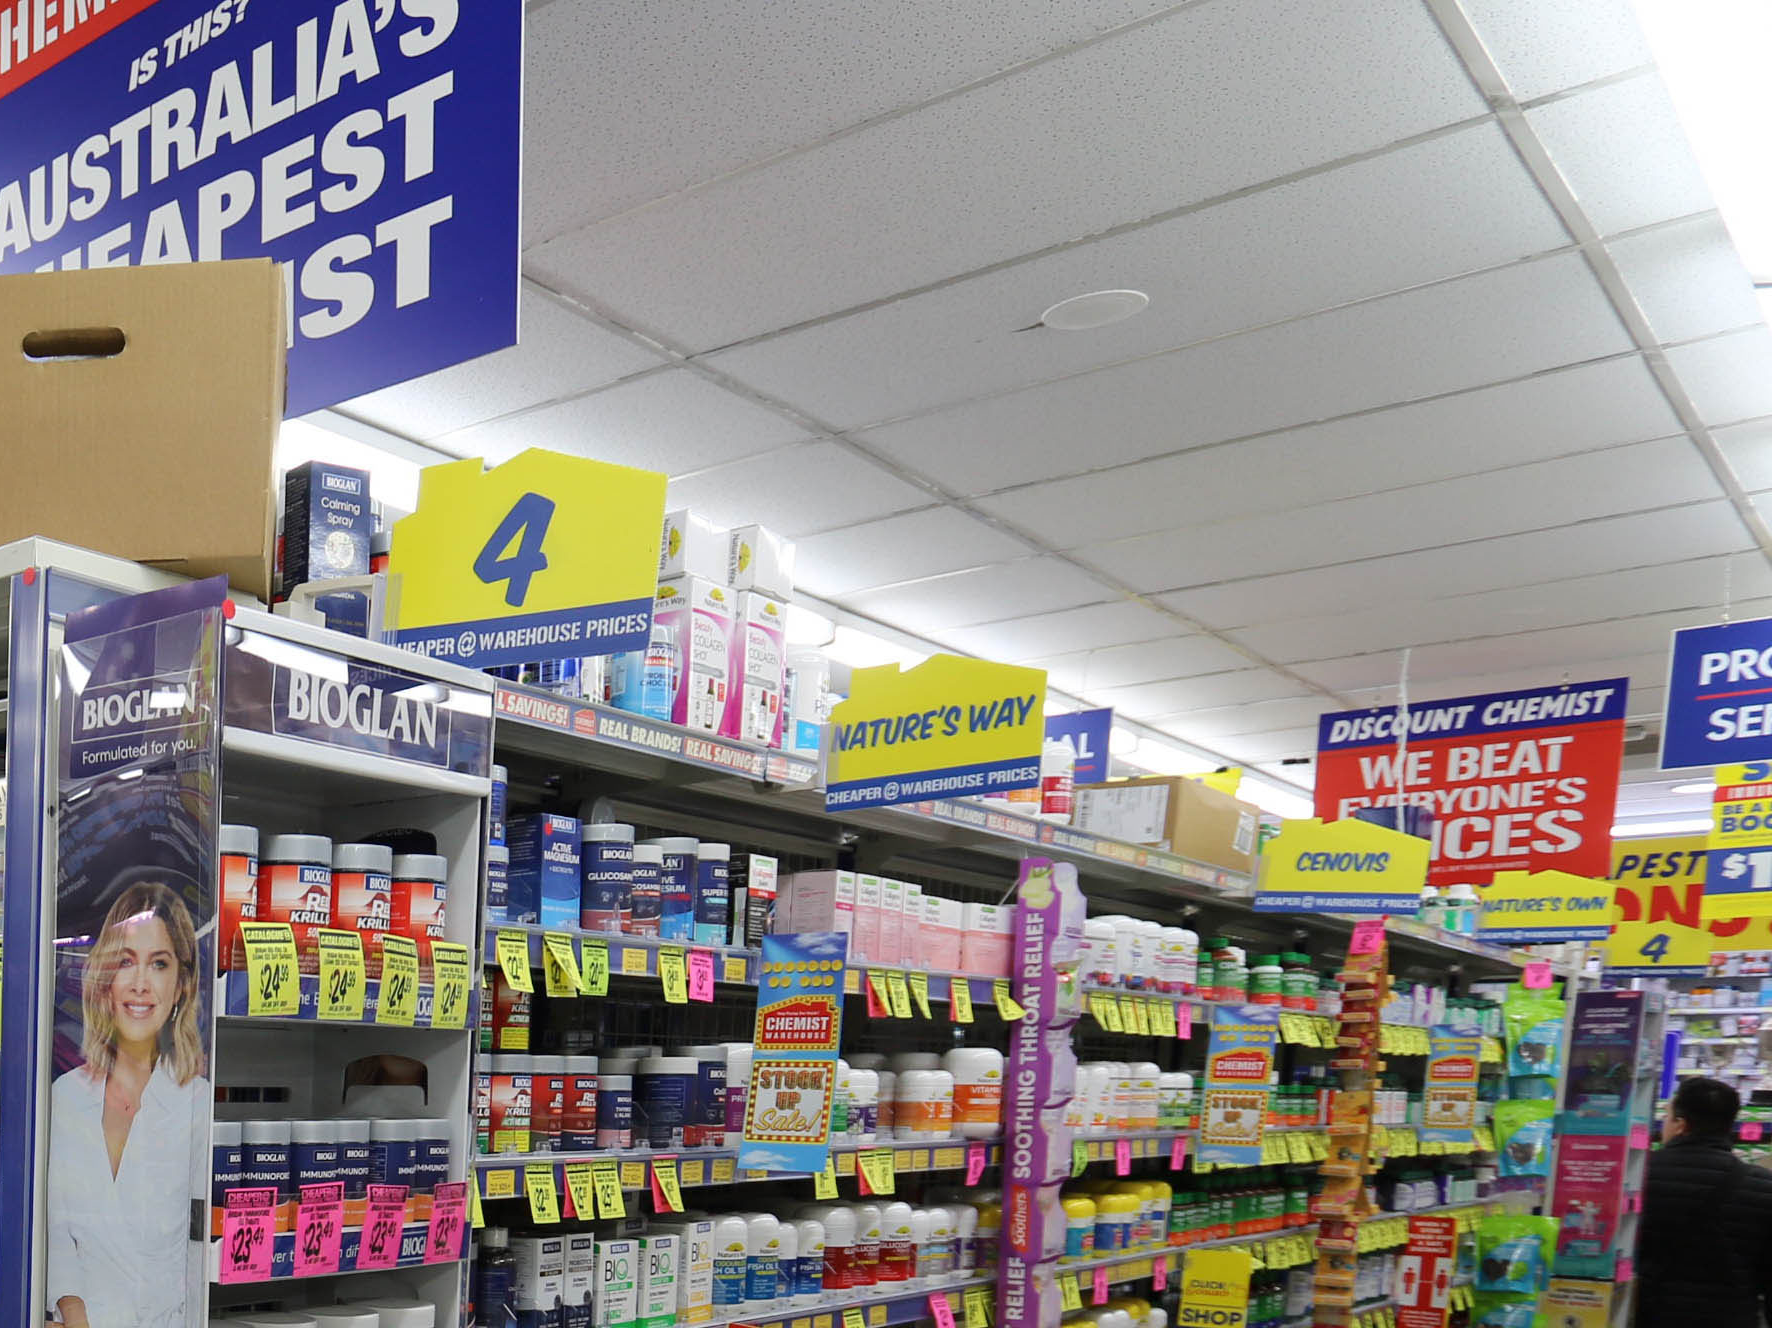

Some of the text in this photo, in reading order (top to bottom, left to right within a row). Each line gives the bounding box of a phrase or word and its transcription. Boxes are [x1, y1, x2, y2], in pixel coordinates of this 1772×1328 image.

[129, 0, 249, 92] IS THIS?
[322, 474, 360, 495] BIOGLAN
[321, 496, 361, 517] Calming
[326, 511, 355, 529] Spray
[472, 491, 557, 607] 4
[479, 611, 648, 651] WAREHOUSE PRICES
[81, 681, 199, 731] BIOGLAN
[287, 671, 438, 748] BIOGLAN
[1328, 687, 1614, 746] DISCOUNT CHEMIST
[599, 720, 683, 754] REAL BRANDS!
[831, 694, 1037, 753] NATURE'S WAY
[81, 738, 198, 765] Formulated for you.
[1359, 736, 1574, 790] WE BEAT
[826, 766, 1039, 806] CHEAPER WAREHOUSE PRICES
[1296, 852, 1391, 873] CENOVIS
[1481, 895, 1608, 914] NATURE'S OWN
[1639, 933, 1671, 963] 4
[765, 1015, 829, 1031] CHEMIST
[765, 1031, 827, 1040] WAREHOUSE
[1013, 912, 1046, 1180] SOOTHING THROAT RELIEF
[760, 1069, 825, 1090] STOCK
[776, 1090, 802, 1110] UP
[755, 1108, 822, 1133] Sale!
[1182, 1307, 1242, 1325] SHOP
